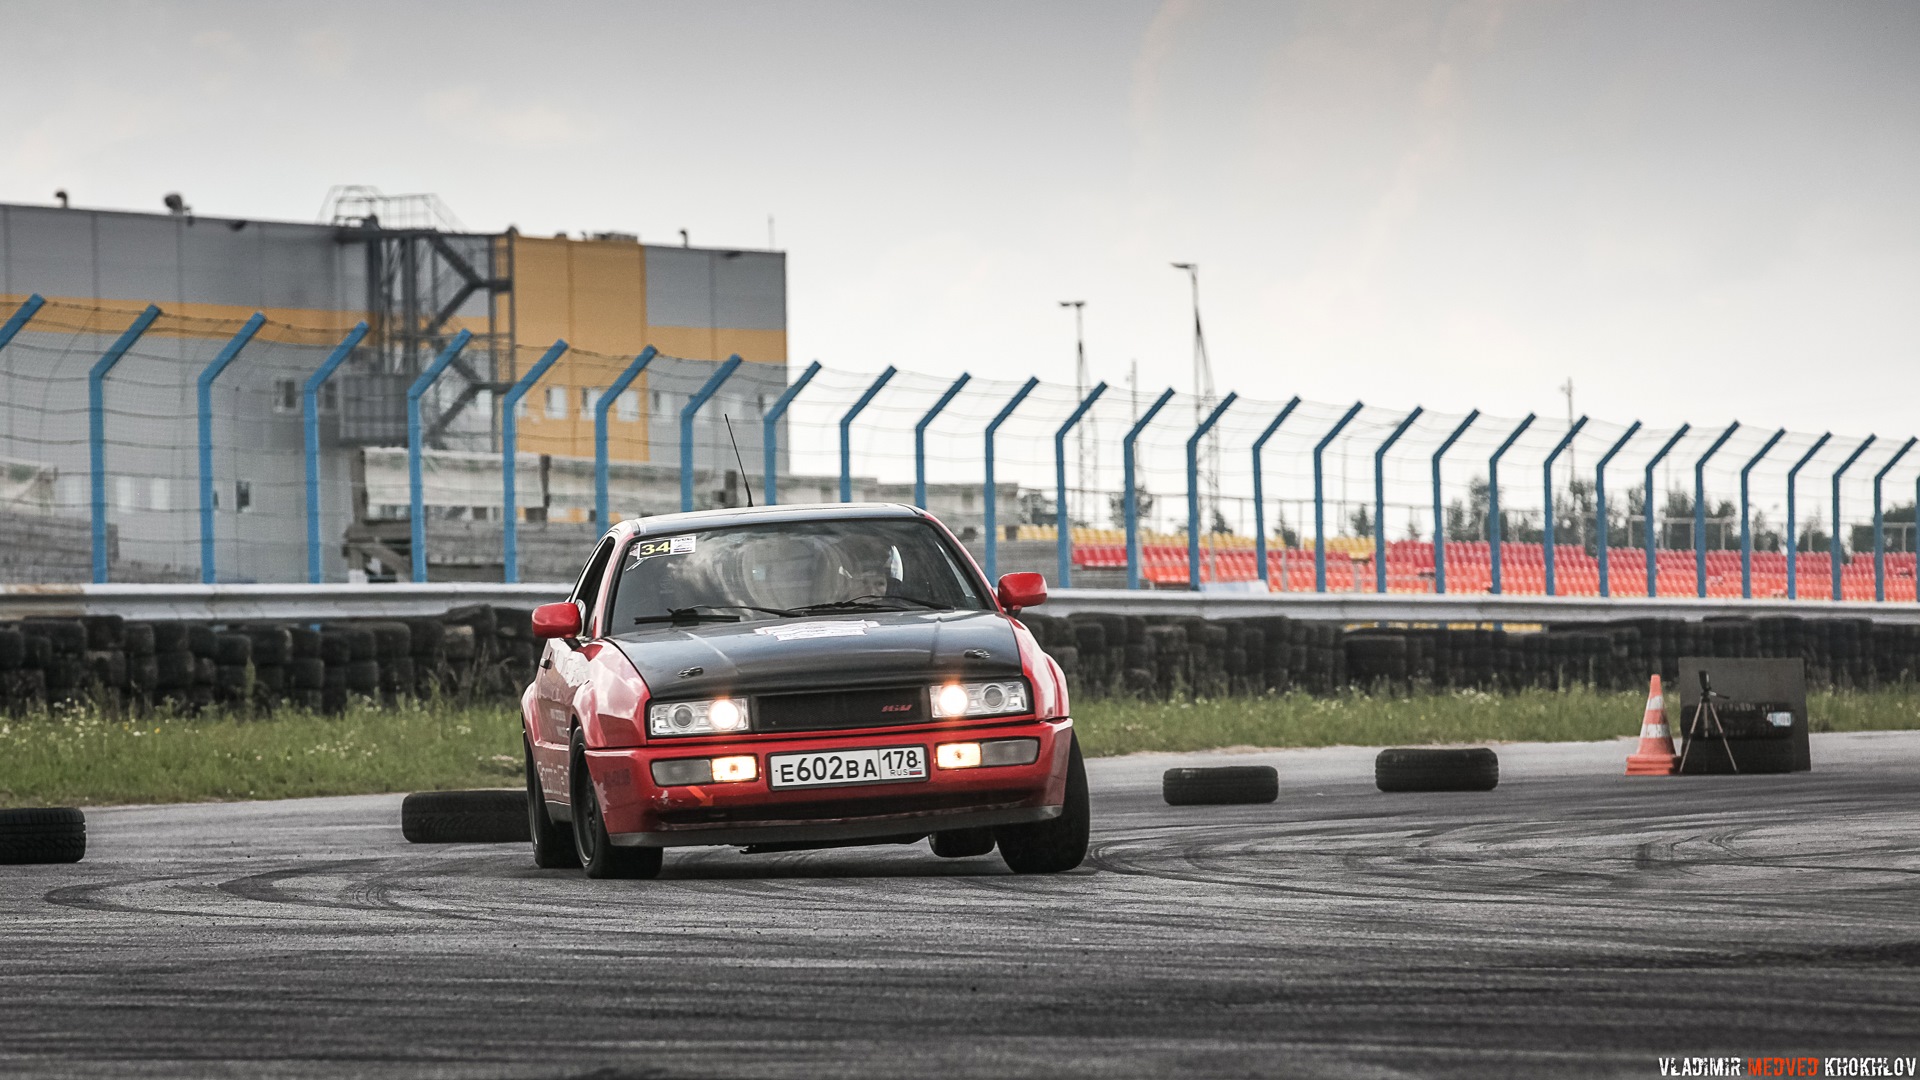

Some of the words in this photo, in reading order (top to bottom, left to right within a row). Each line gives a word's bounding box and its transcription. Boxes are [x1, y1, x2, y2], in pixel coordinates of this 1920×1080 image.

[641, 541, 670, 556] 34
[881, 750, 918, 770] 178
[889, 769, 908, 777] RUS
